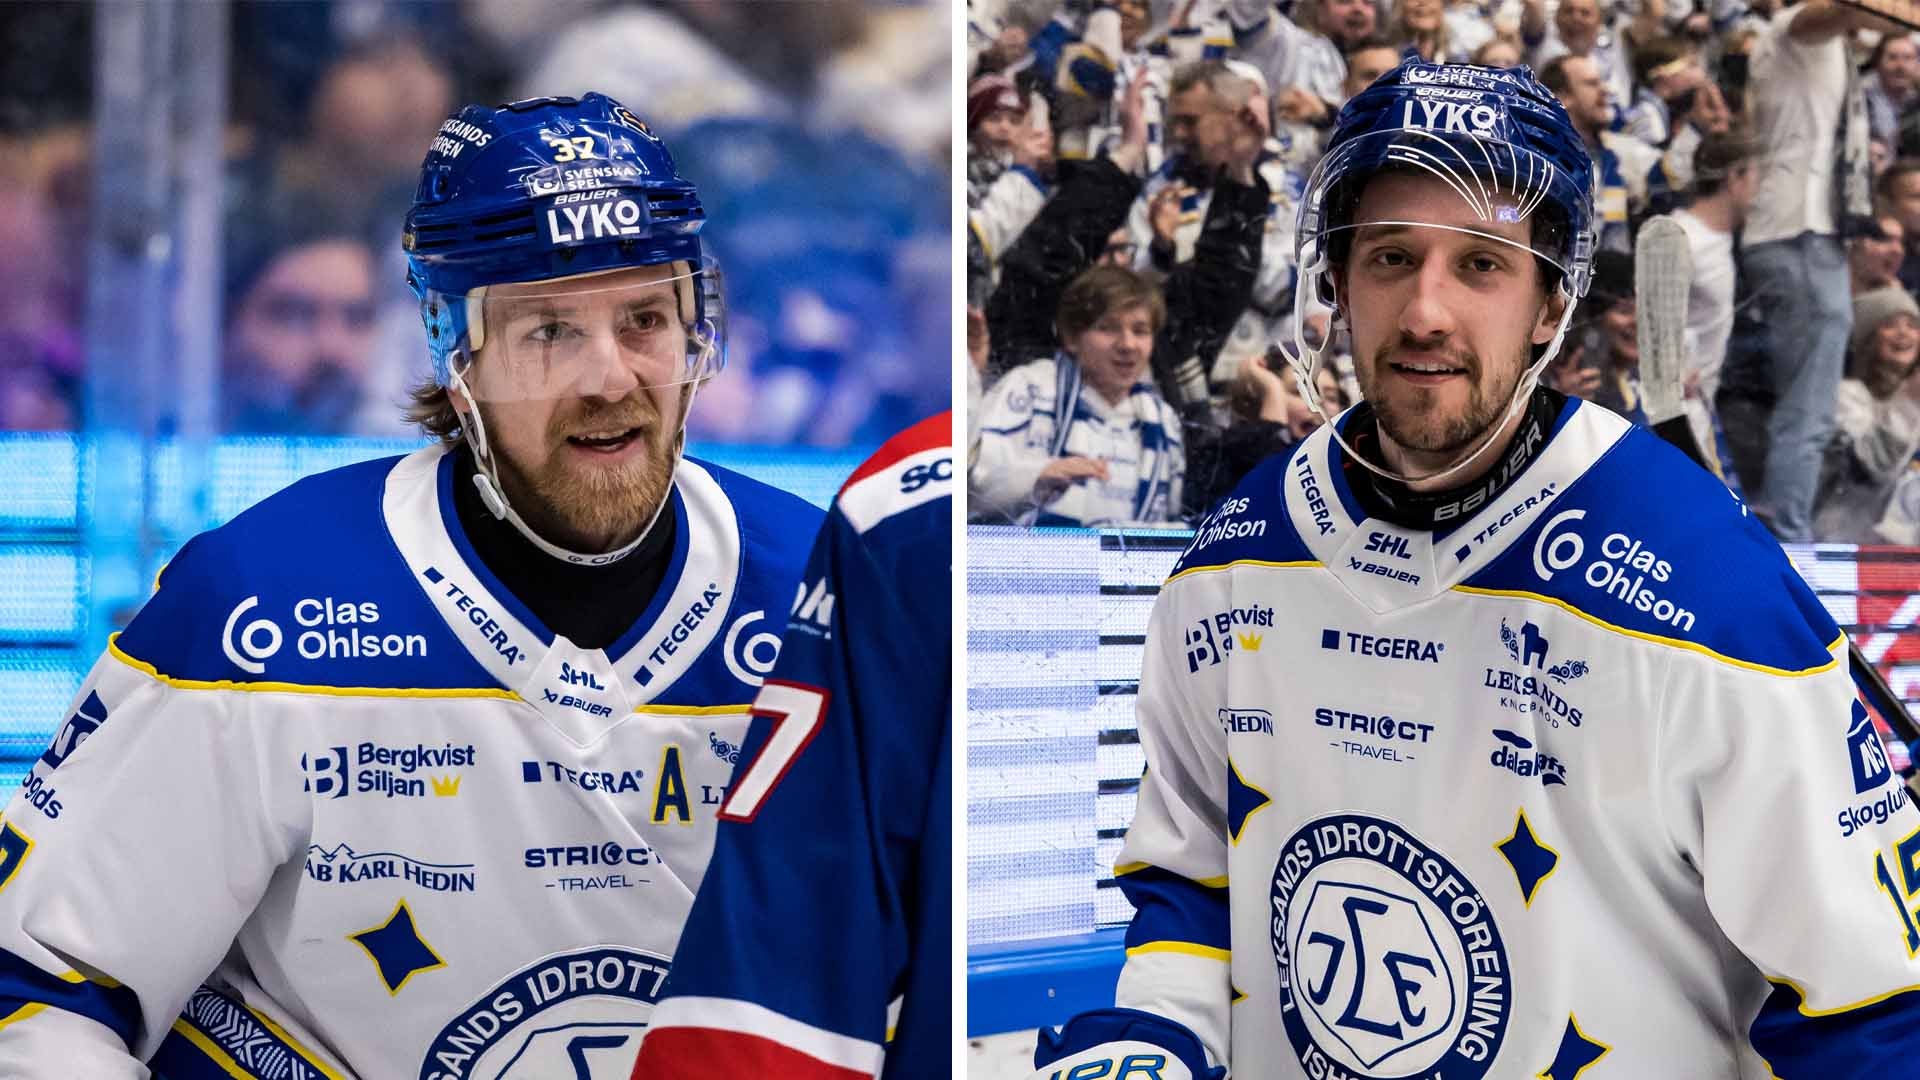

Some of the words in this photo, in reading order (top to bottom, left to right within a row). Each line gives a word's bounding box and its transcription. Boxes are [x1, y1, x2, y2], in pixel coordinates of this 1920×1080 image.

[1440, 73, 1476, 87] SPEL
[1442, 67, 1511, 83] SVENSKA
[1402, 100, 1497, 137] LYKO
[549, 136, 595, 162] 37
[564, 167, 634, 181] SVENSKA
[566, 178, 605, 191] SPEL
[547, 200, 641, 244] LYKO
[1198, 518, 1267, 551] Ohlson
[1364, 532, 1412, 560] SHL
[1601, 532, 1673, 583] Clas
[1585, 561, 1696, 632] Ohlson
[294, 597, 380, 626] Clas
[297, 627, 428, 660] Ohlson
[558, 662, 605, 691] SHL
[357, 743, 476, 773] Bergkvist
[716, 680, 832, 822] 7
[1342, 741, 1403, 762] TRAVEL
[357, 770, 425, 797] Siljan
[649, 743, 695, 826] A
[338, 860, 400, 884] KARL
[403, 861, 475, 893] HEDIN
[558, 875, 634, 892] TRAVEL
[1272, 837, 1314, 1014] LEKSANDS
[1312, 822, 1503, 1063] IDROTTSFÖRENING
